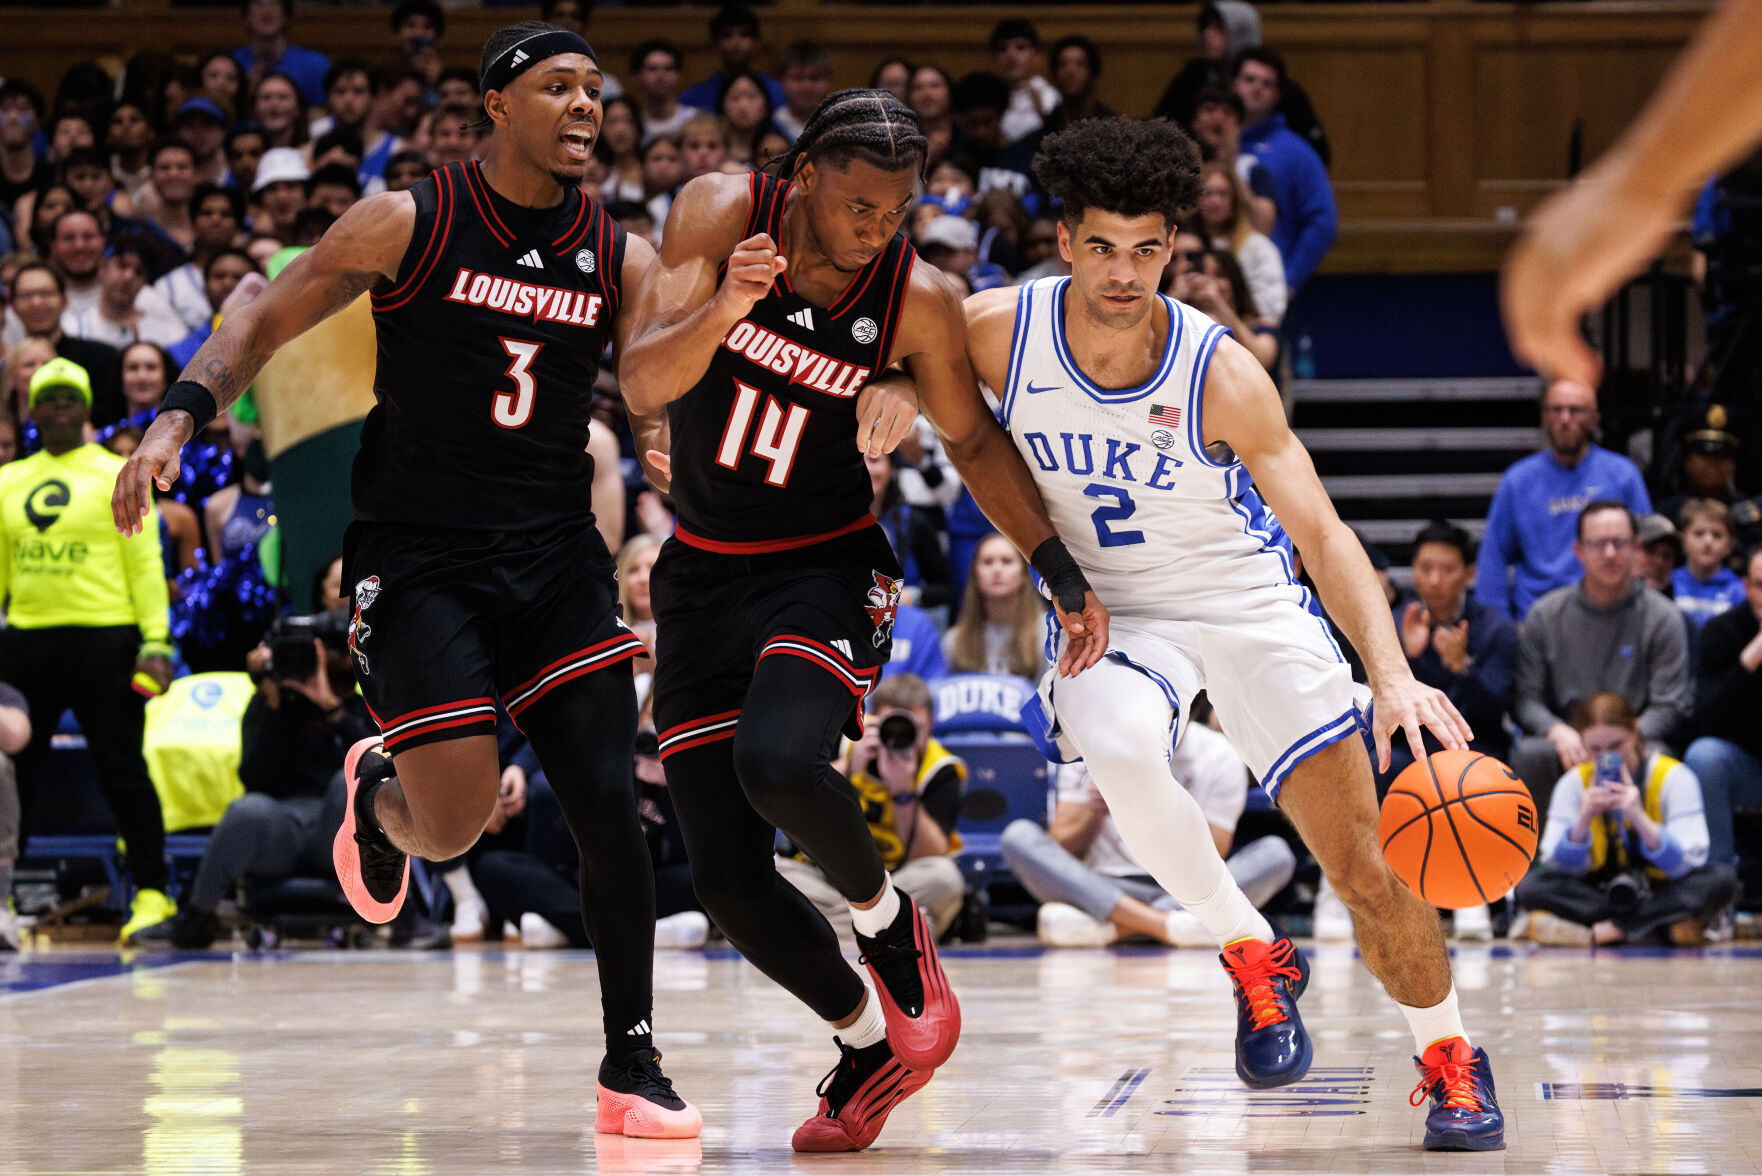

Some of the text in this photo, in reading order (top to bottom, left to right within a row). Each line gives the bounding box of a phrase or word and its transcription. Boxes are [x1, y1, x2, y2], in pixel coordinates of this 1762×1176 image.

[443, 267, 603, 328] LOUISVILLE
[491, 336, 546, 429] 3
[720, 319, 870, 398] OUISVILLE
[715, 376, 811, 488] 14
[1024, 432, 1184, 491] DUKE
[1083, 483, 1146, 547] 2
[937, 679, 1022, 723] DUKE
[1517, 804, 1538, 835] EL
